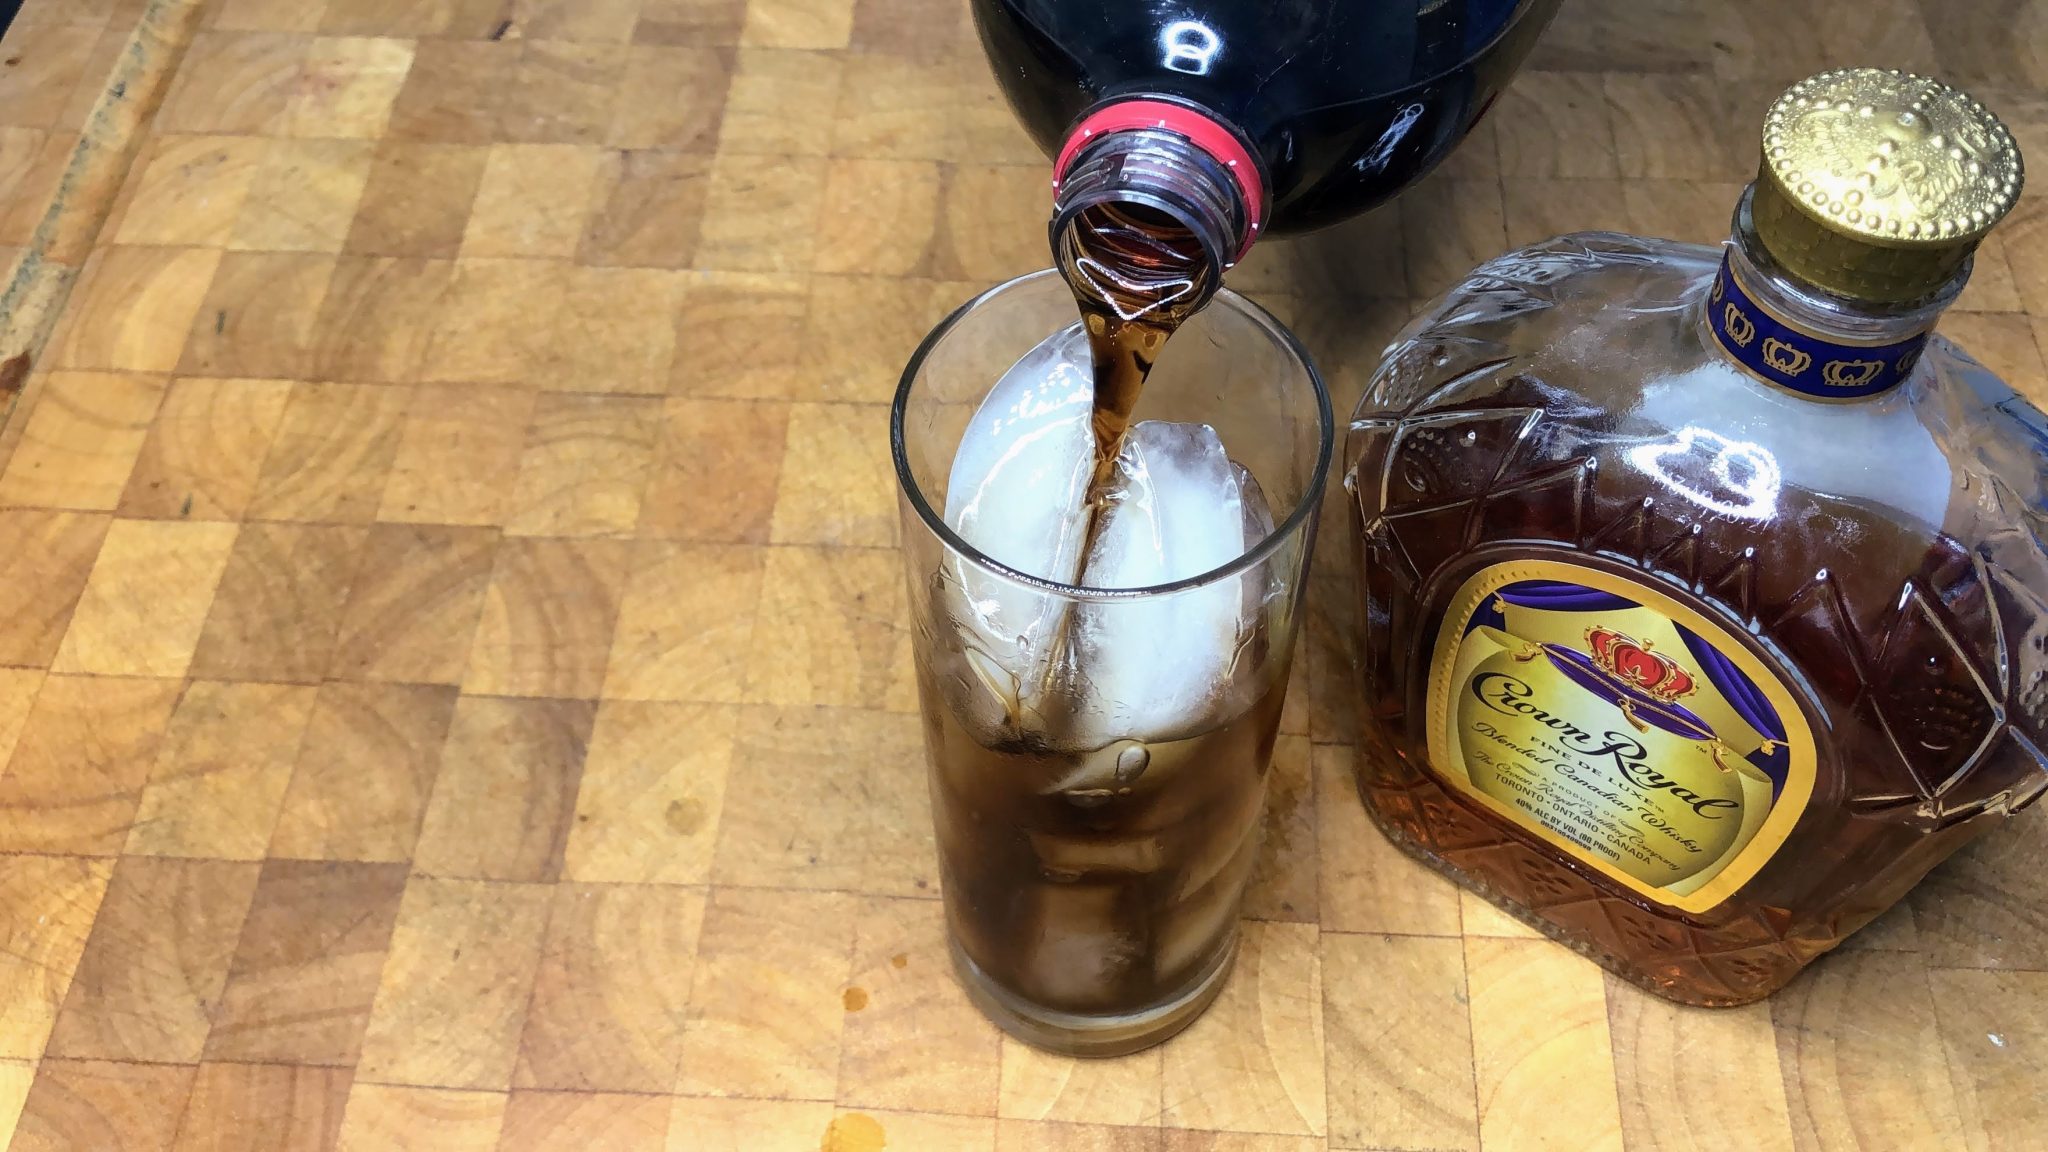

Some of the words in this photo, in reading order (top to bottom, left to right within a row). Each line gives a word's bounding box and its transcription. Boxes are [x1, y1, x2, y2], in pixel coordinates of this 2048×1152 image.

[1472, 672, 1591, 744] Crown
[1559, 731, 1739, 819] Royal
[1472, 722, 1555, 764] Blended
[1554, 764, 1633, 812] Canadian
[1637, 806, 1702, 853] Whisky
[1530, 736, 1572, 760] FINE
[1578, 760, 1602, 777] DE
[1473, 750, 1494, 766] The
[1496, 763, 1533, 786] Crown
[1534, 783, 1578, 807] Royal
[1579, 804, 1627, 838] Distilling
[1628, 835, 1680, 871] Company
[1496, 772, 1544, 803] TORONTO
[1552, 802, 1599, 833] ONTARIO
[1606, 834, 1651, 865] CANADA
[1515, 798, 1533, 812] 40%
[1534, 807, 1549, 820] ALC
[1550, 815, 1561, 825] BY
[1563, 822, 1577, 836] VOL
[1593, 841, 1621, 862] PROOF)
[1551, 781, 1599, 809] PRODUCT
